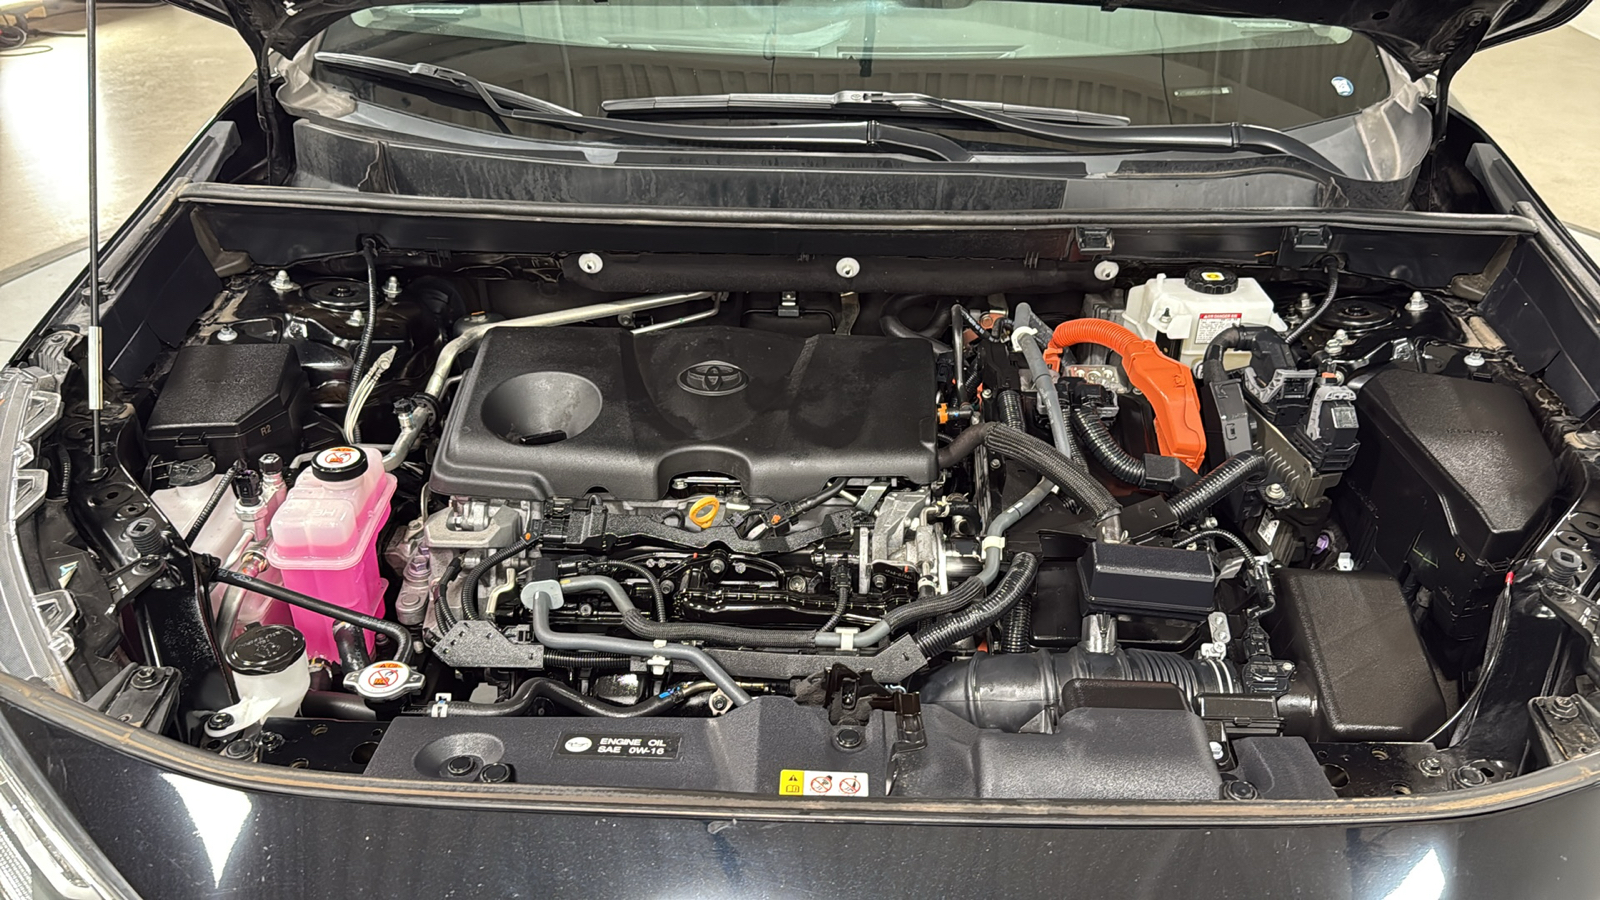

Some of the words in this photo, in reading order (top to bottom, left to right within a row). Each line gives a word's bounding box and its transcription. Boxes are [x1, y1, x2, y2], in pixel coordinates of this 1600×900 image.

[260, 424, 272, 437] R2
[1454, 546, 1466, 562] L3
[600, 737, 642, 746] ENGINE
[647, 739, 667, 747] OIL
[597, 746, 622, 754] SAE
[628, 746, 665, 755] 0W-16
